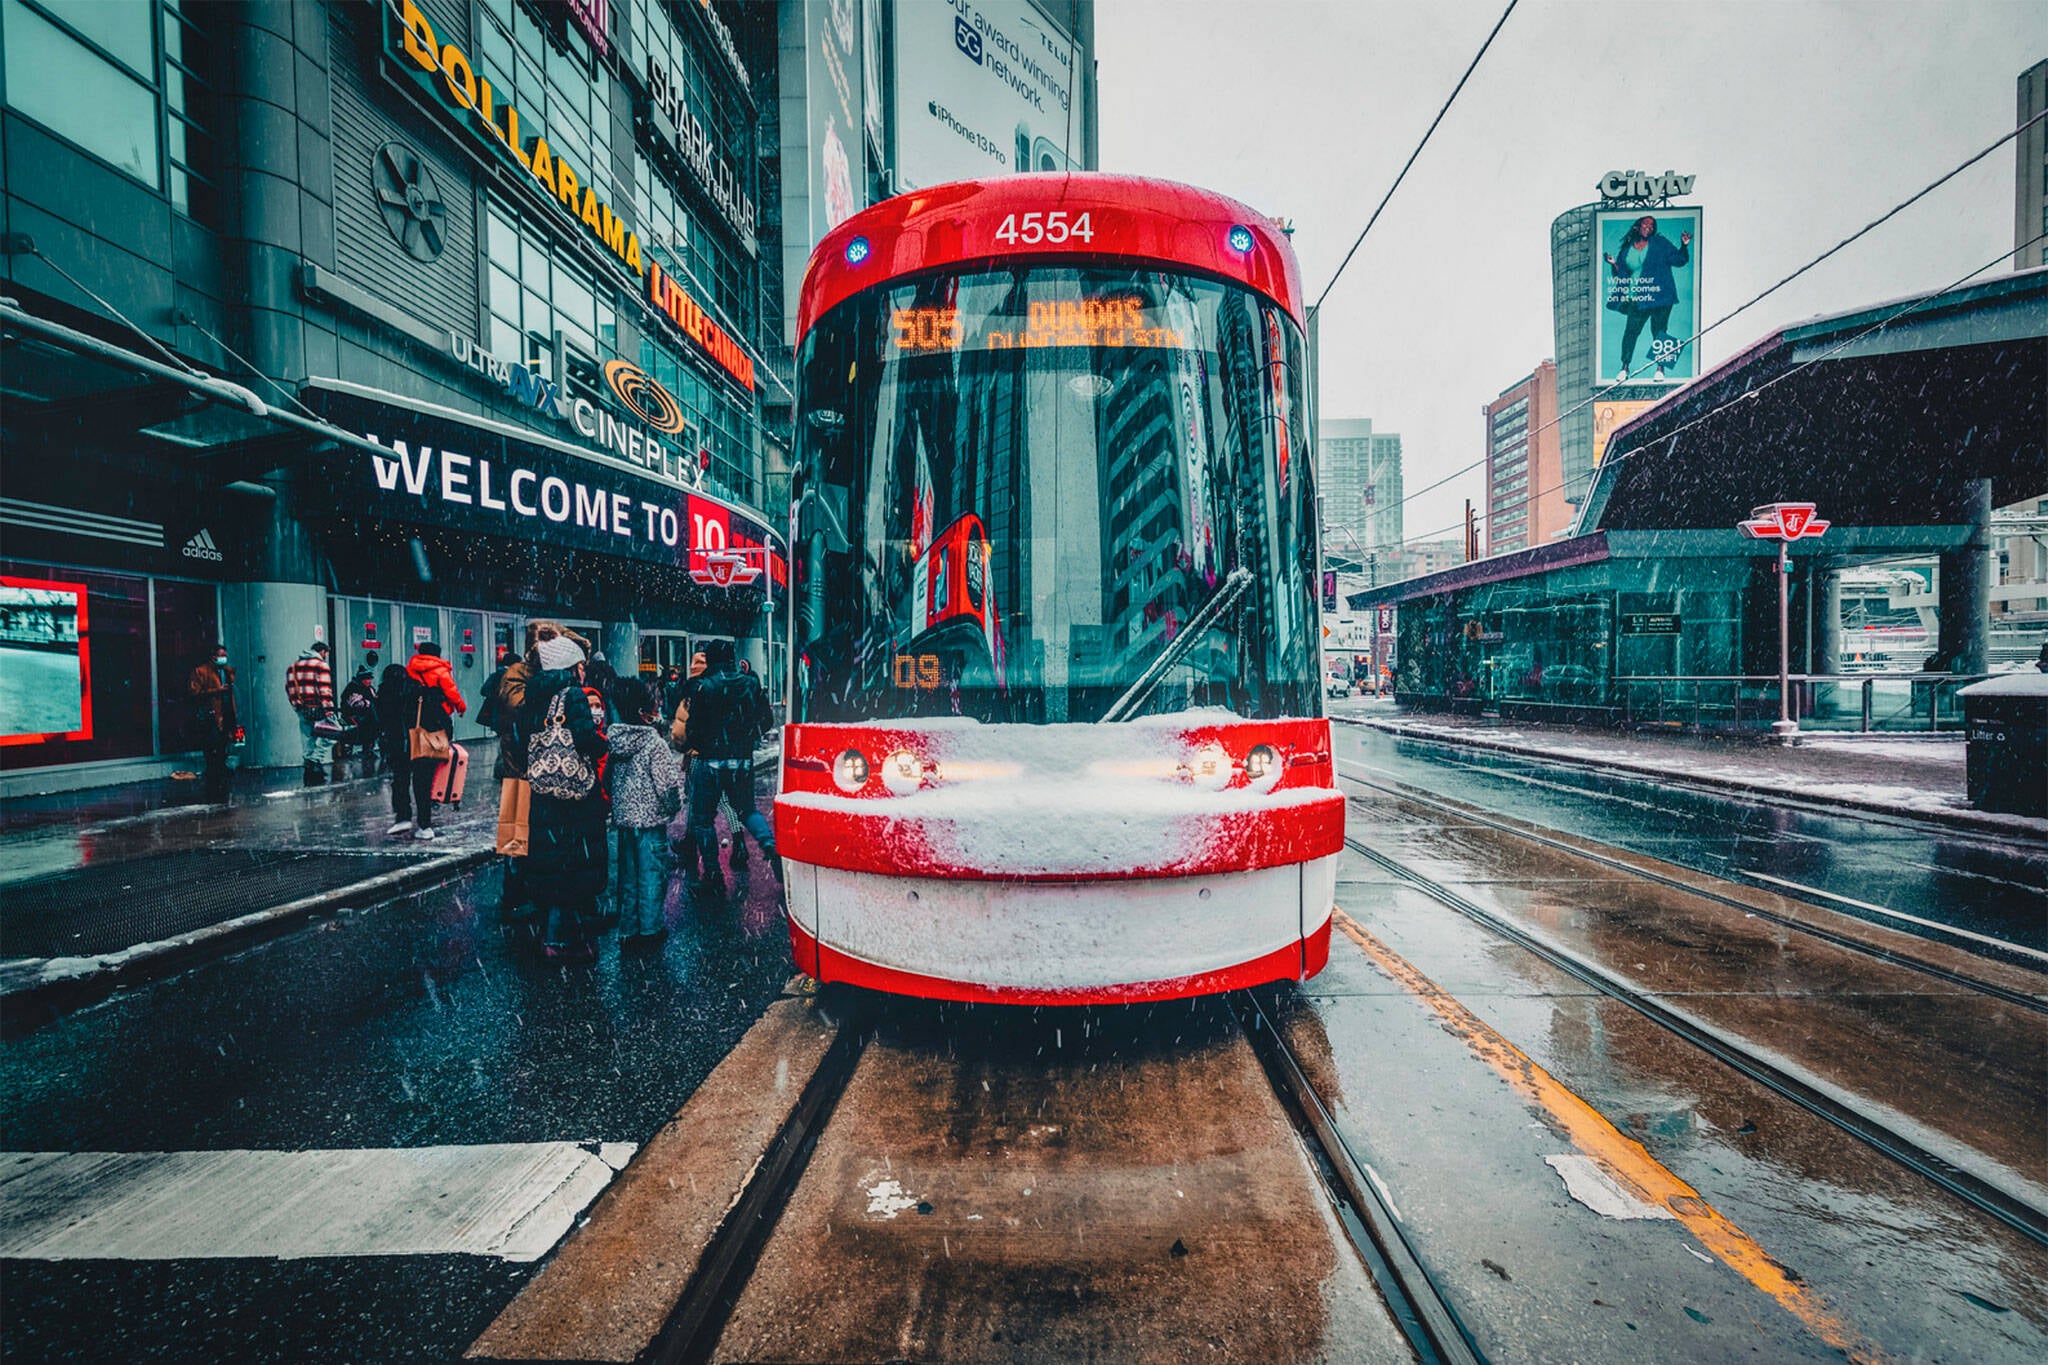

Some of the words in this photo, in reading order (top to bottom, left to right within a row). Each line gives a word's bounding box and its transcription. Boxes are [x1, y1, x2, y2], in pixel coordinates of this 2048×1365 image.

[957, 25, 980, 57] 5G
[986, 52, 1045, 114] network.
[974, 12, 1019, 62] award
[1020, 52, 1069, 112] winning
[1040, 32, 1074, 72] TELUS
[404, 0, 643, 277] DOLLARAMA
[652, 54, 714, 182] SHARK
[937, 104, 975, 144] iPhone
[976, 133, 988, 152] 13
[989, 141, 1006, 165] Pro
[1600, 169, 1696, 201] Citytv
[996, 211, 1094, 244] 4554
[1607, 276, 1633, 285] When
[1634, 276, 1655, 286] your
[1608, 286, 1630, 295] song
[893, 310, 963, 348] 505
[1029, 297, 1142, 331] DUNDAS
[569, 397, 706, 493] CINEPLEX
[367, 433, 632, 538] WELCOME
[642, 503, 679, 547] TO
[694, 513, 726, 560] 10
[182, 546, 223, 562] adidas
[895, 653, 940, 688] 09
[1972, 729, 1994, 741] Litter
